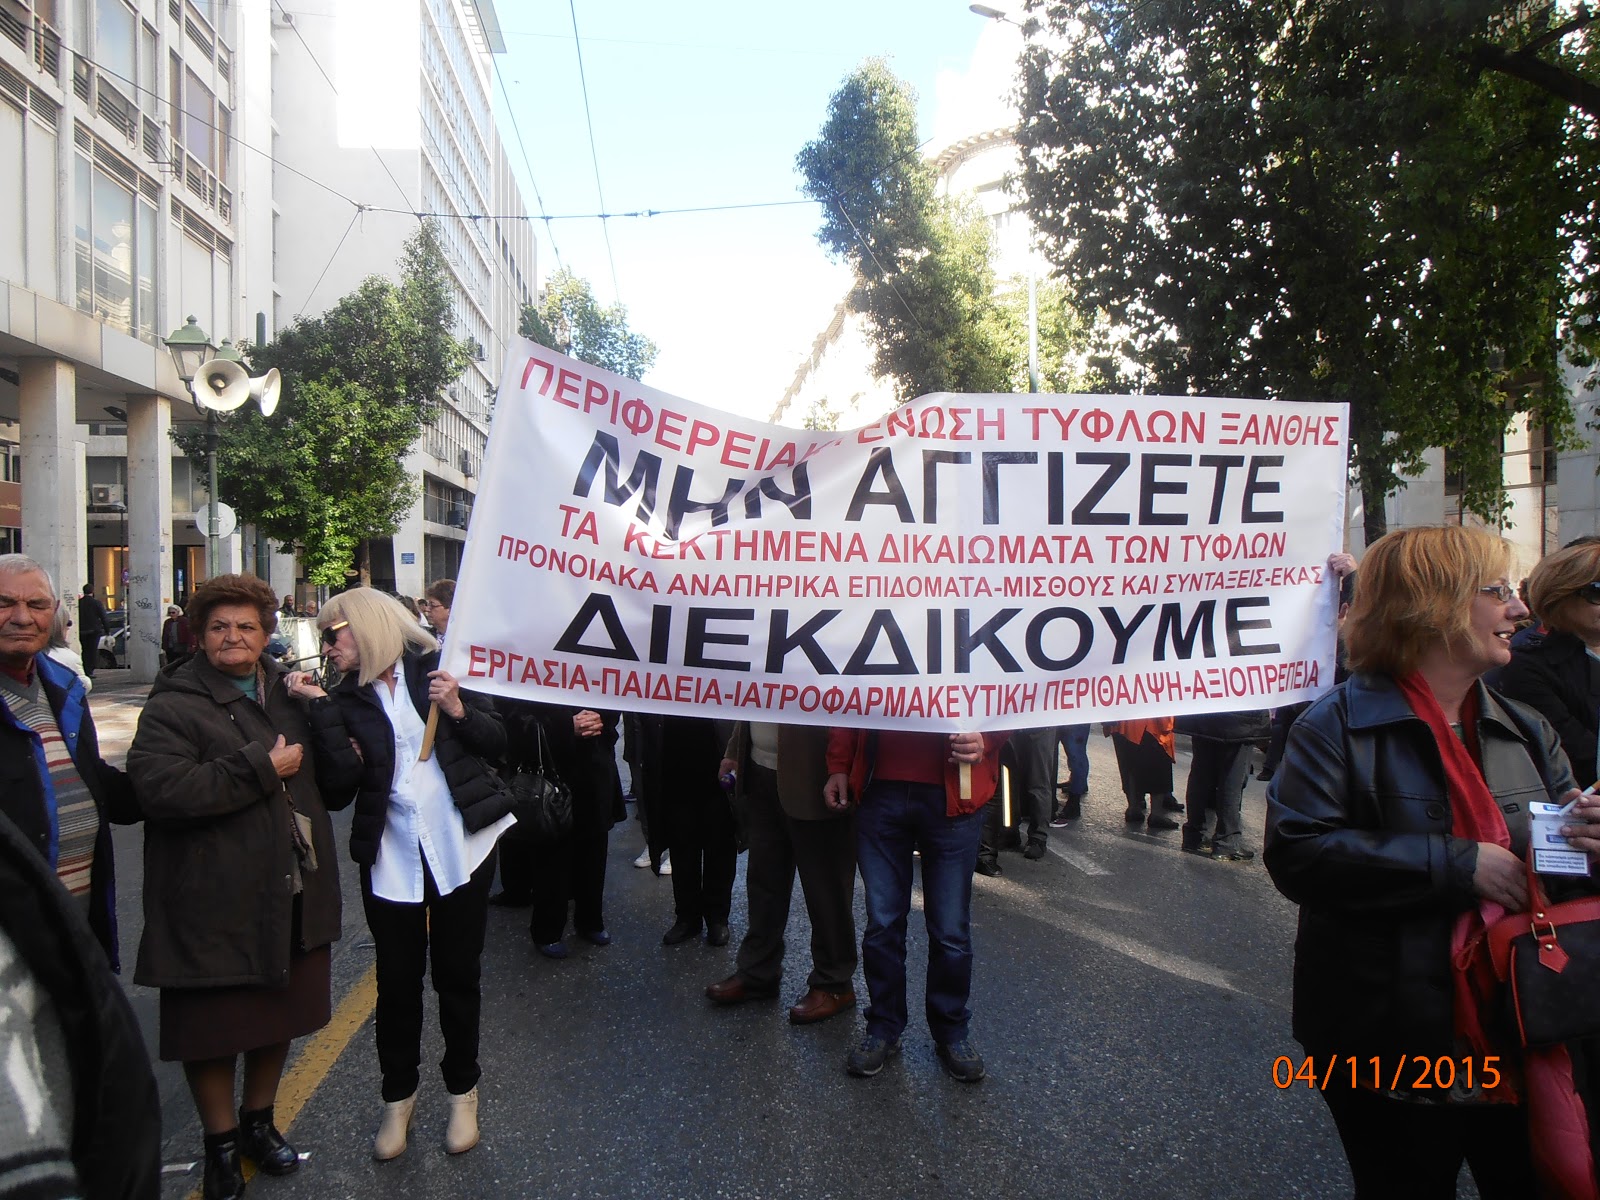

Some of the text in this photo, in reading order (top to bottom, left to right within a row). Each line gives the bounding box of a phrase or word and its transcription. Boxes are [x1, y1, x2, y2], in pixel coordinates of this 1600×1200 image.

[521, 357, 1340, 471] ΠΕΡΙΦΕΡΕΙΑΚ ΕΝΩΣΗ ΤΥΦΛΩΝ ΞΑΝΘΗΣ
[573, 430, 1285, 540] ΜΗΝ ΑΓΓΙΖΕΤΕ
[498, 535, 1323, 599] ΠΡΟΝΟΙΑΚΑ ΑΝΑΠΗΡΙΚΑ ΕΠΙΔΟΜΑΤΑ-ΜΙΣΘΟΥΣ ΚΑΙ ΣΥΝΤΑΞΕΙΣ-ΕΚΑΣ
[559, 504, 1287, 564] ΤΑ ΚΕΚΤΗΜΕΝΑ ΔΙΚΑΙΩΜΑΤΑ ΤΩΝ ΤΥΦΛΩΝ
[552, 592, 1281, 675] ΔΙΕΚΔΙΚΟΥΜΕ
[1045, 659, 1319, 710] ΠΕΡΙΘΑΛΨΗ-ΑΞΙΟΠΡΕΠΕΙΑ
